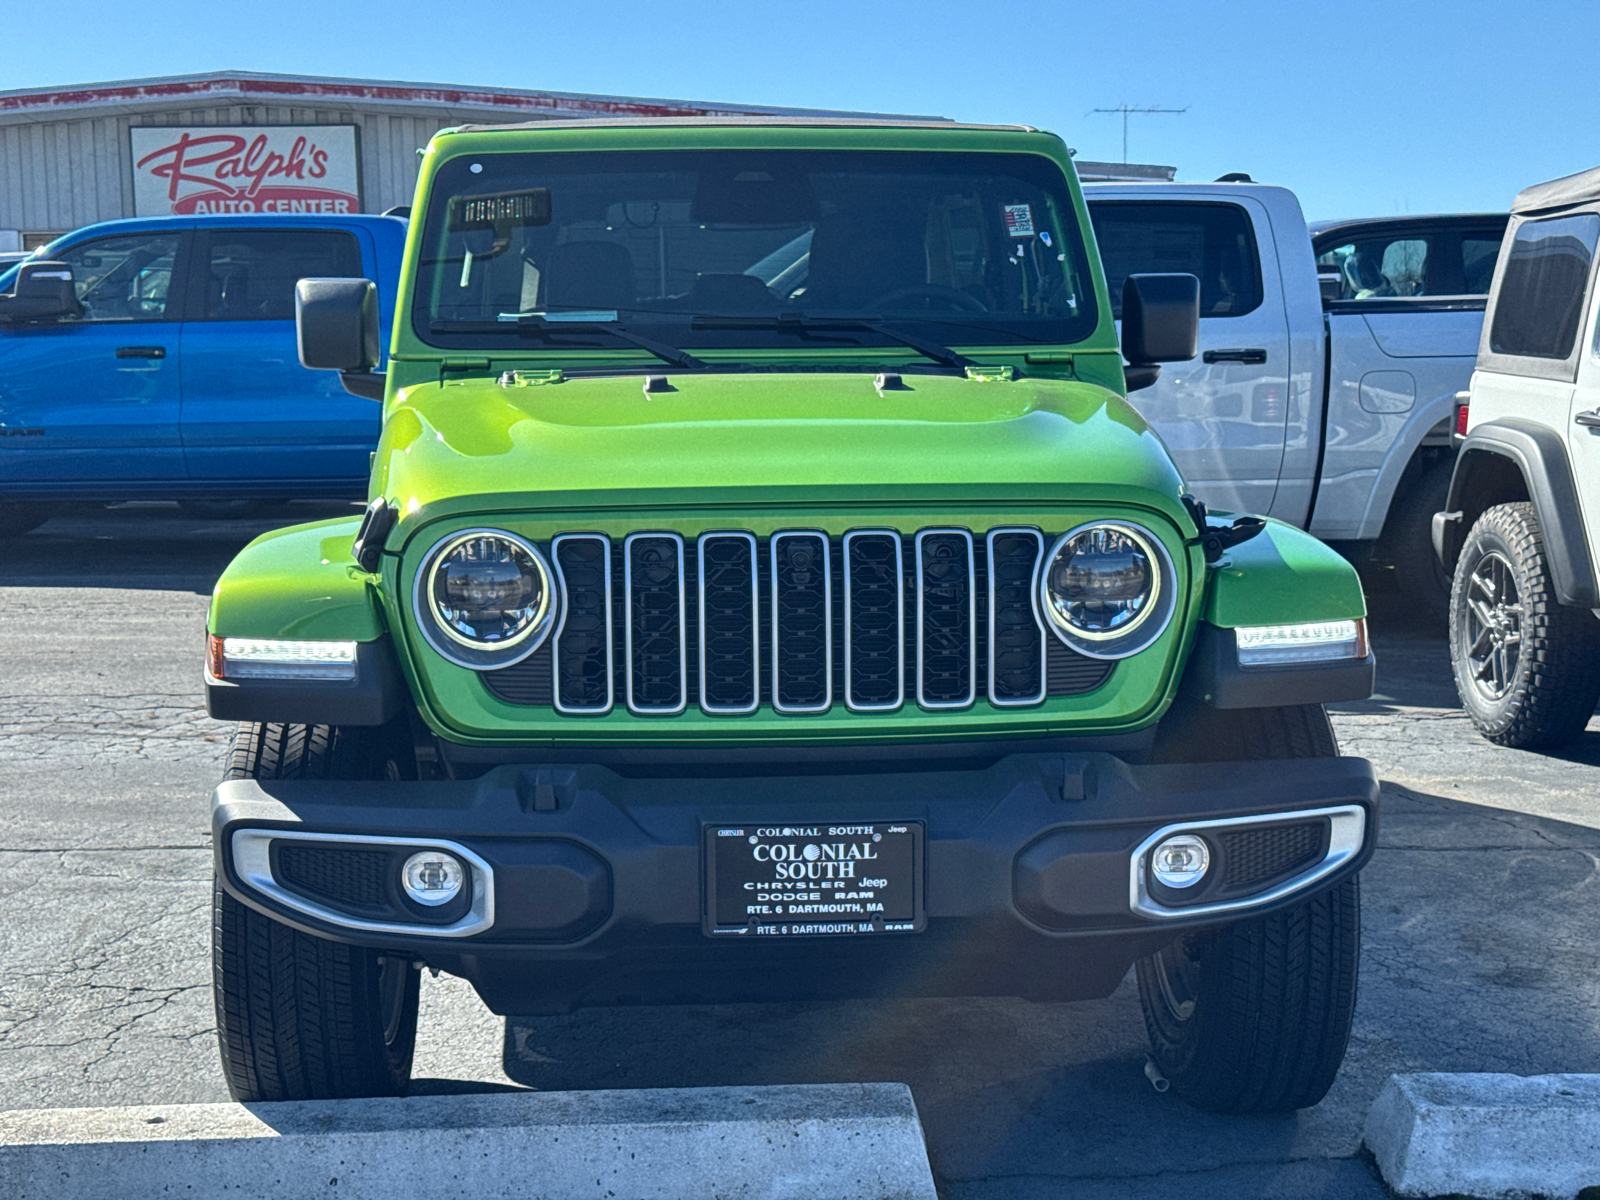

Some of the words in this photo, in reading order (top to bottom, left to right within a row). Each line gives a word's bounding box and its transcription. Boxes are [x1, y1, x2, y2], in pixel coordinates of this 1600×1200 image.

[136, 132, 328, 201] Ralph's
[194, 199, 255, 214] AUTO
[262, 199, 350, 214] CENTER
[756, 827, 821, 837] COLONIAL
[828, 826, 874, 836] SOUTH
[887, 825, 907, 834] Jeep
[753, 842, 878, 862] COLONIAL
[775, 861, 856, 880] SOUTH
[743, 881, 846, 890] CHRYSLER
[858, 877, 888, 888] Jeep
[757, 892, 821, 901] DODGE
[834, 891, 874, 900] RAM
[747, 905, 772, 914] RTE.
[775, 905, 783, 914] 6
[788, 903, 864, 914] DARTMOUTH,
[866, 903, 884, 912] MA
[757, 926, 779, 935] RTE.
[781, 925, 788, 935] 6
[792, 924, 857, 934] DARTMOUTH,
[859, 923, 874, 932] MA
